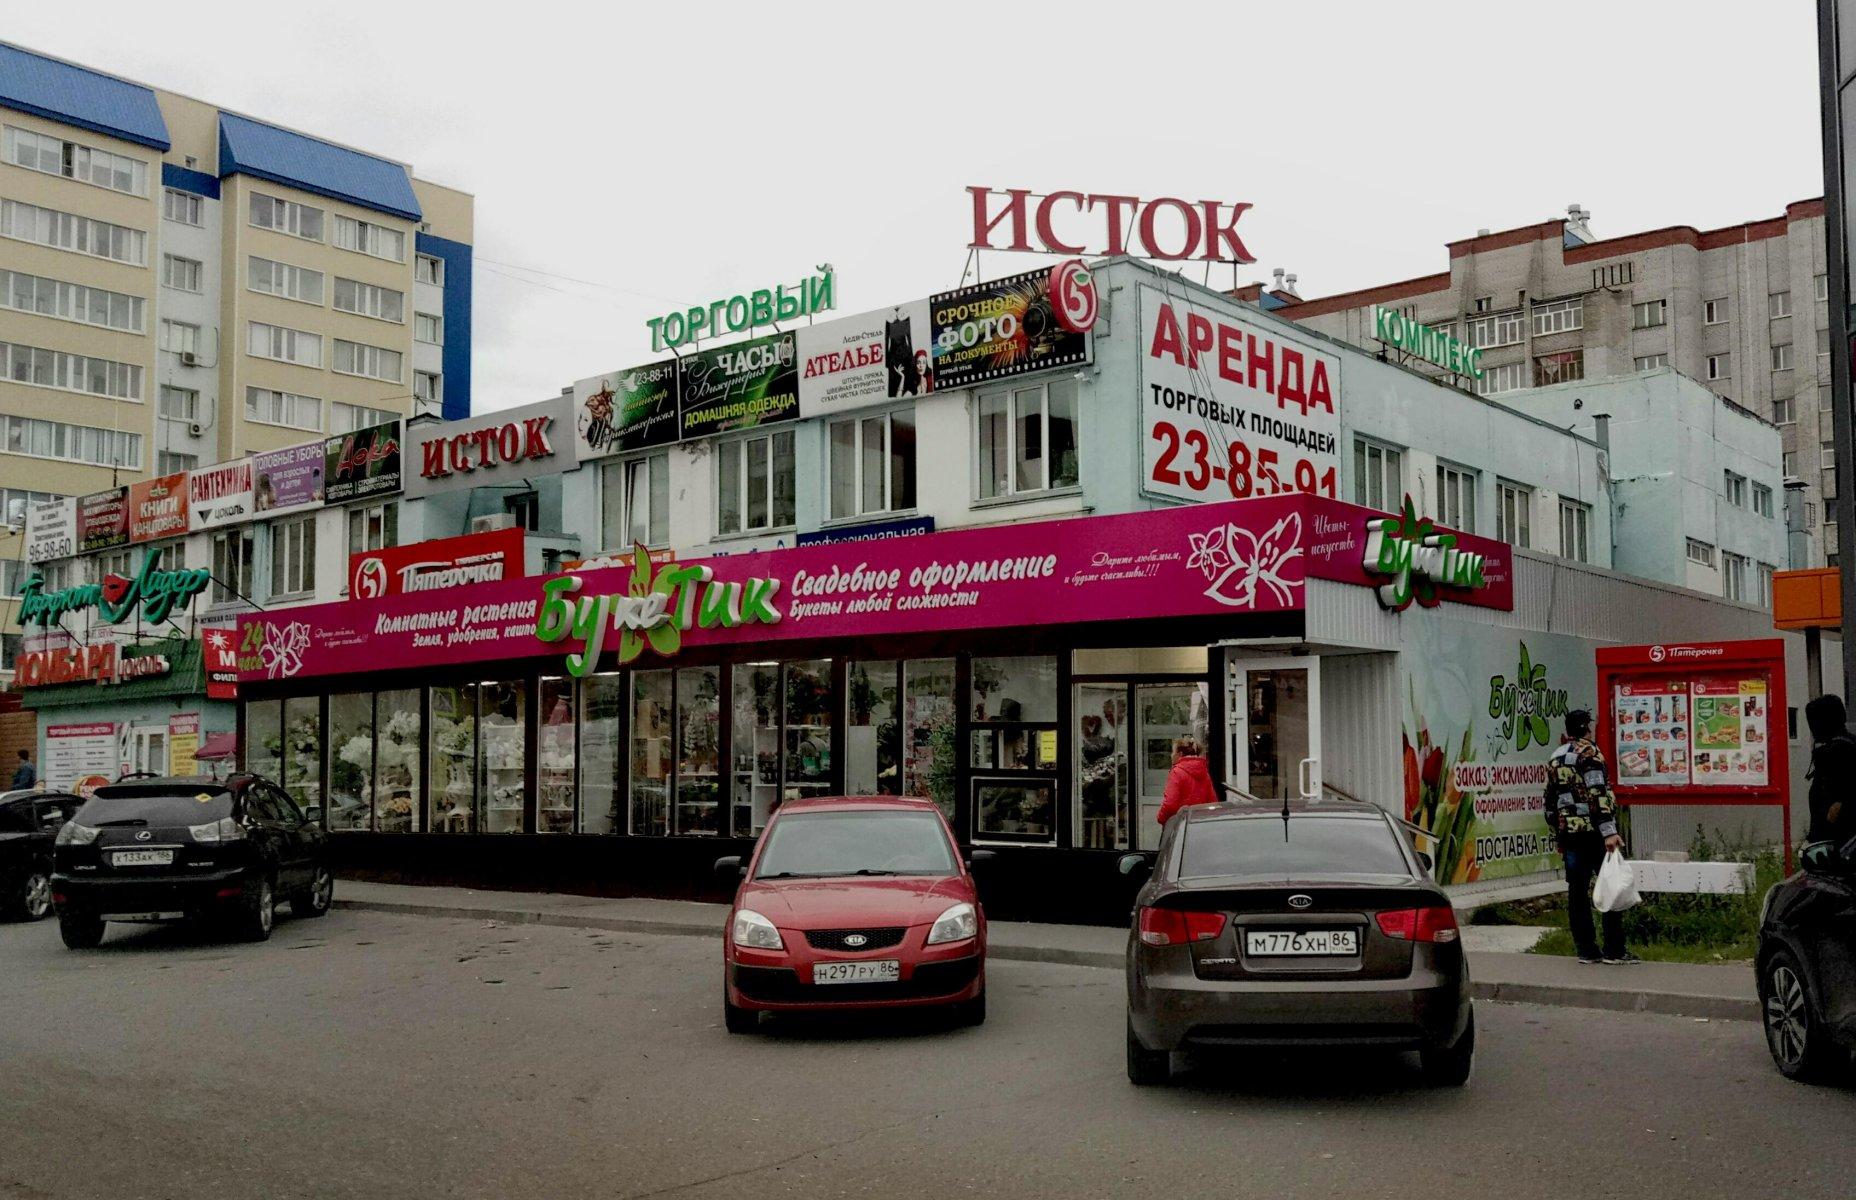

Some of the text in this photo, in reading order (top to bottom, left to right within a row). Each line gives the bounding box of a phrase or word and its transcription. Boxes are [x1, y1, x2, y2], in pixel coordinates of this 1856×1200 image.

[966, 186, 1258, 264] ИСТОК
[647, 263, 837, 352] ТОРГОВЫЙ
[936, 294, 1015, 325] СРОЧНОЕ
[937, 313, 1017, 351] ФОТО
[1370, 304, 1485, 380] КОМПЛЕКС
[717, 342, 781, 376] ЧАСЫ
[803, 343, 884, 379] АТЕЛЬЕ
[938, 340, 1018, 365] НА ДОКУМЕНТЫ
[1151, 303, 1335, 417] АРЕНДА
[686, 360, 766, 402] Бижутерия
[685, 402, 747, 429] ДОМАШНЯЯ
[748, 392, 797, 416] ОДЕЖДА
[1151, 383, 1336, 455] ТОРГОВЫХ ПЛОЩАДЕЙ
[256, 444, 325, 470] ГОЛОВНЫЕ УБОРЫ
[420, 415, 554, 478] ИСТОК
[1152, 421, 1336, 500] 23-85-91
[191, 464, 252, 504] САНТЕХНИКА
[140, 496, 178, 517] КНИГИ
[214, 504, 245, 519] ЦОКОЛЬ
[132, 514, 186, 537] КАНЦТОВАРЫ
[29, 538, 71, 561] 96-98-60
[1091, 551, 1133, 569] Дарите
[99, 547, 211, 626] Лидер
[791, 553, 1057, 596] Свадебное оформление
[375, 599, 537, 635] Комнатные растения
[789, 589, 980, 622] Букеты любой сложности
[241, 621, 264, 652] 24
[412, 623, 537, 648] Земля, удобрения, кашпо
[12, 640, 120, 688] ЛОМБАРД
[1668, 646, 1724, 659] Пятерочка
[1491, 764, 1549, 786] эксклюзив
[1475, 797, 1526, 819] оформление
[1476, 835, 1539, 863] ДОСТАВКА
[1291, 897, 1309, 905] KIA
[848, 936, 865, 945] KIA
[1332, 932, 1350, 946] 86
